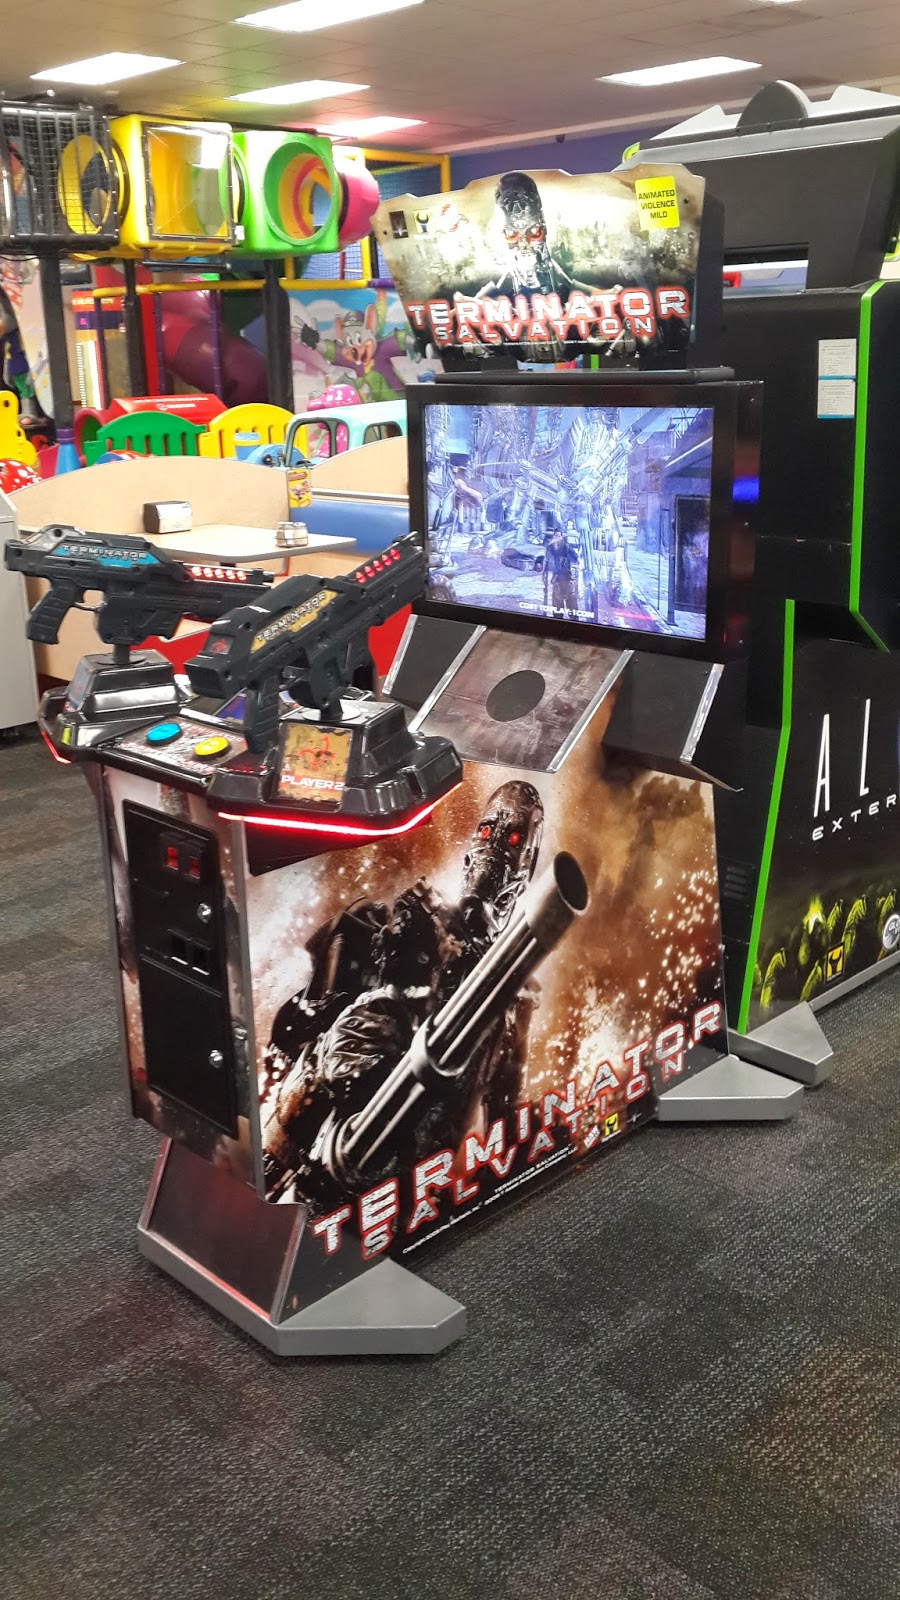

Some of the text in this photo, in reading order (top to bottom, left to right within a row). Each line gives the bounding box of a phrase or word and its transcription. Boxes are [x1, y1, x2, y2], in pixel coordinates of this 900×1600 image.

[638, 189, 675, 200] ANIMATED
[641, 200, 676, 210] VIOLENCE
[650, 211, 668, 219] MILD
[408, 289, 688, 327] TERMINATOR
[435, 316, 653, 341] SALVATION
[63, 544, 148, 559] TERMINATOR
[256, 592, 326, 641] TERMINATOR
[281, 774, 345, 791] PLAYER 2
[313, 1002, 721, 1254] TERMINATOR
[363, 1055, 684, 1258] SALVATION
